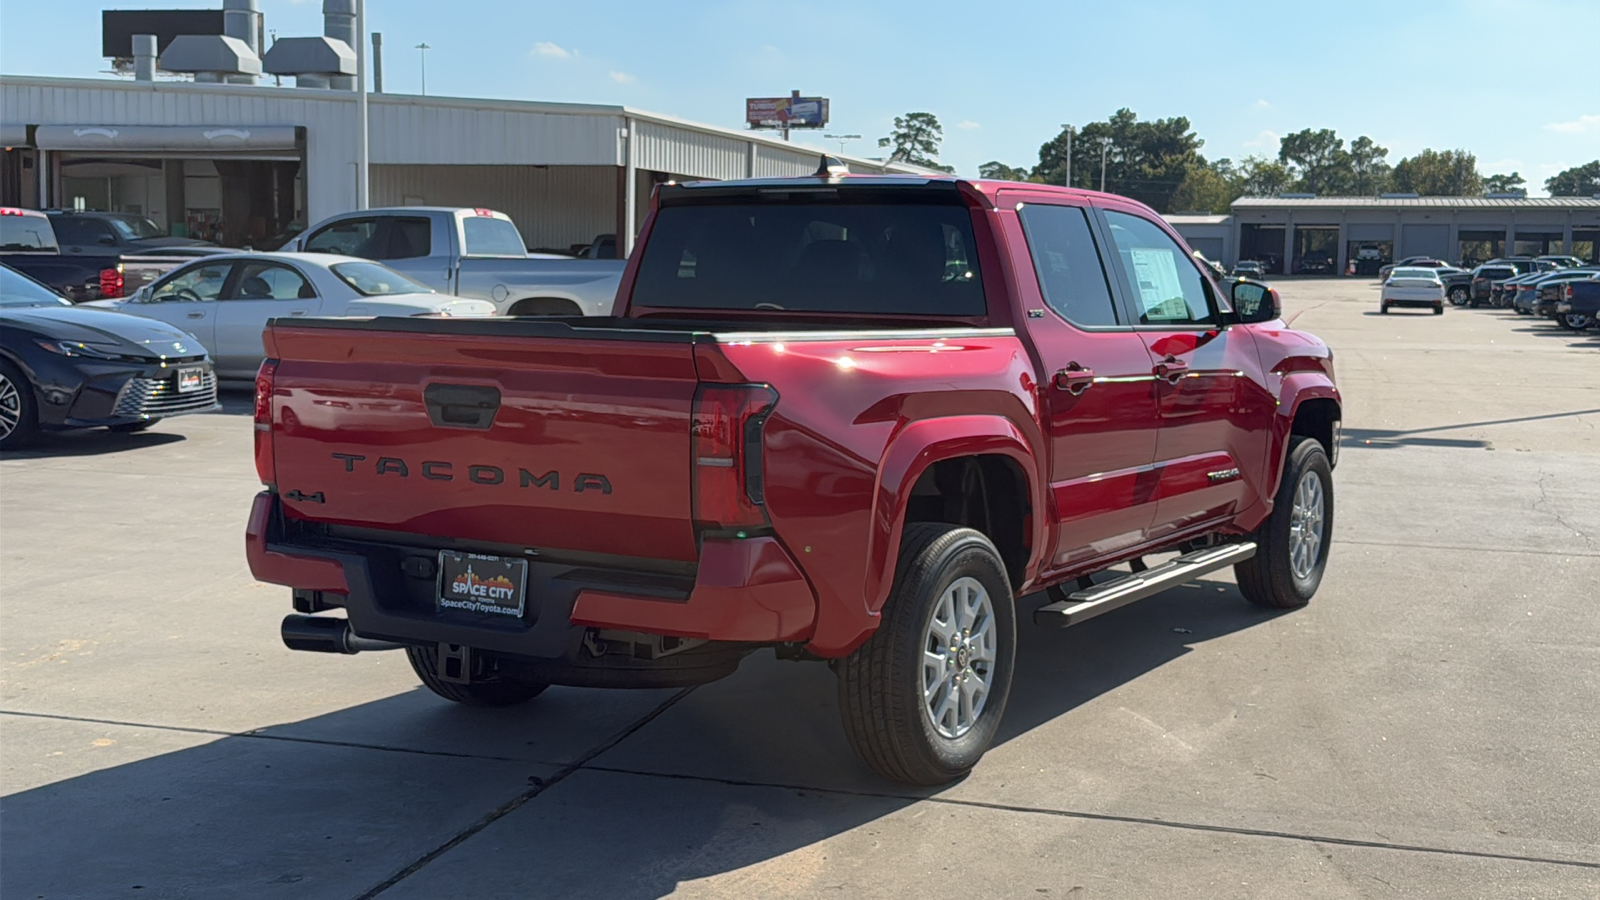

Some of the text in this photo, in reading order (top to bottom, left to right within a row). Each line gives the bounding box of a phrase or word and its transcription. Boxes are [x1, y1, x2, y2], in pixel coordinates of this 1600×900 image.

[332, 452, 613, 495] TACOMA
[452, 581, 514, 600] SPACE CITY
[440, 597, 519, 615] SpaceCityToyota.com
